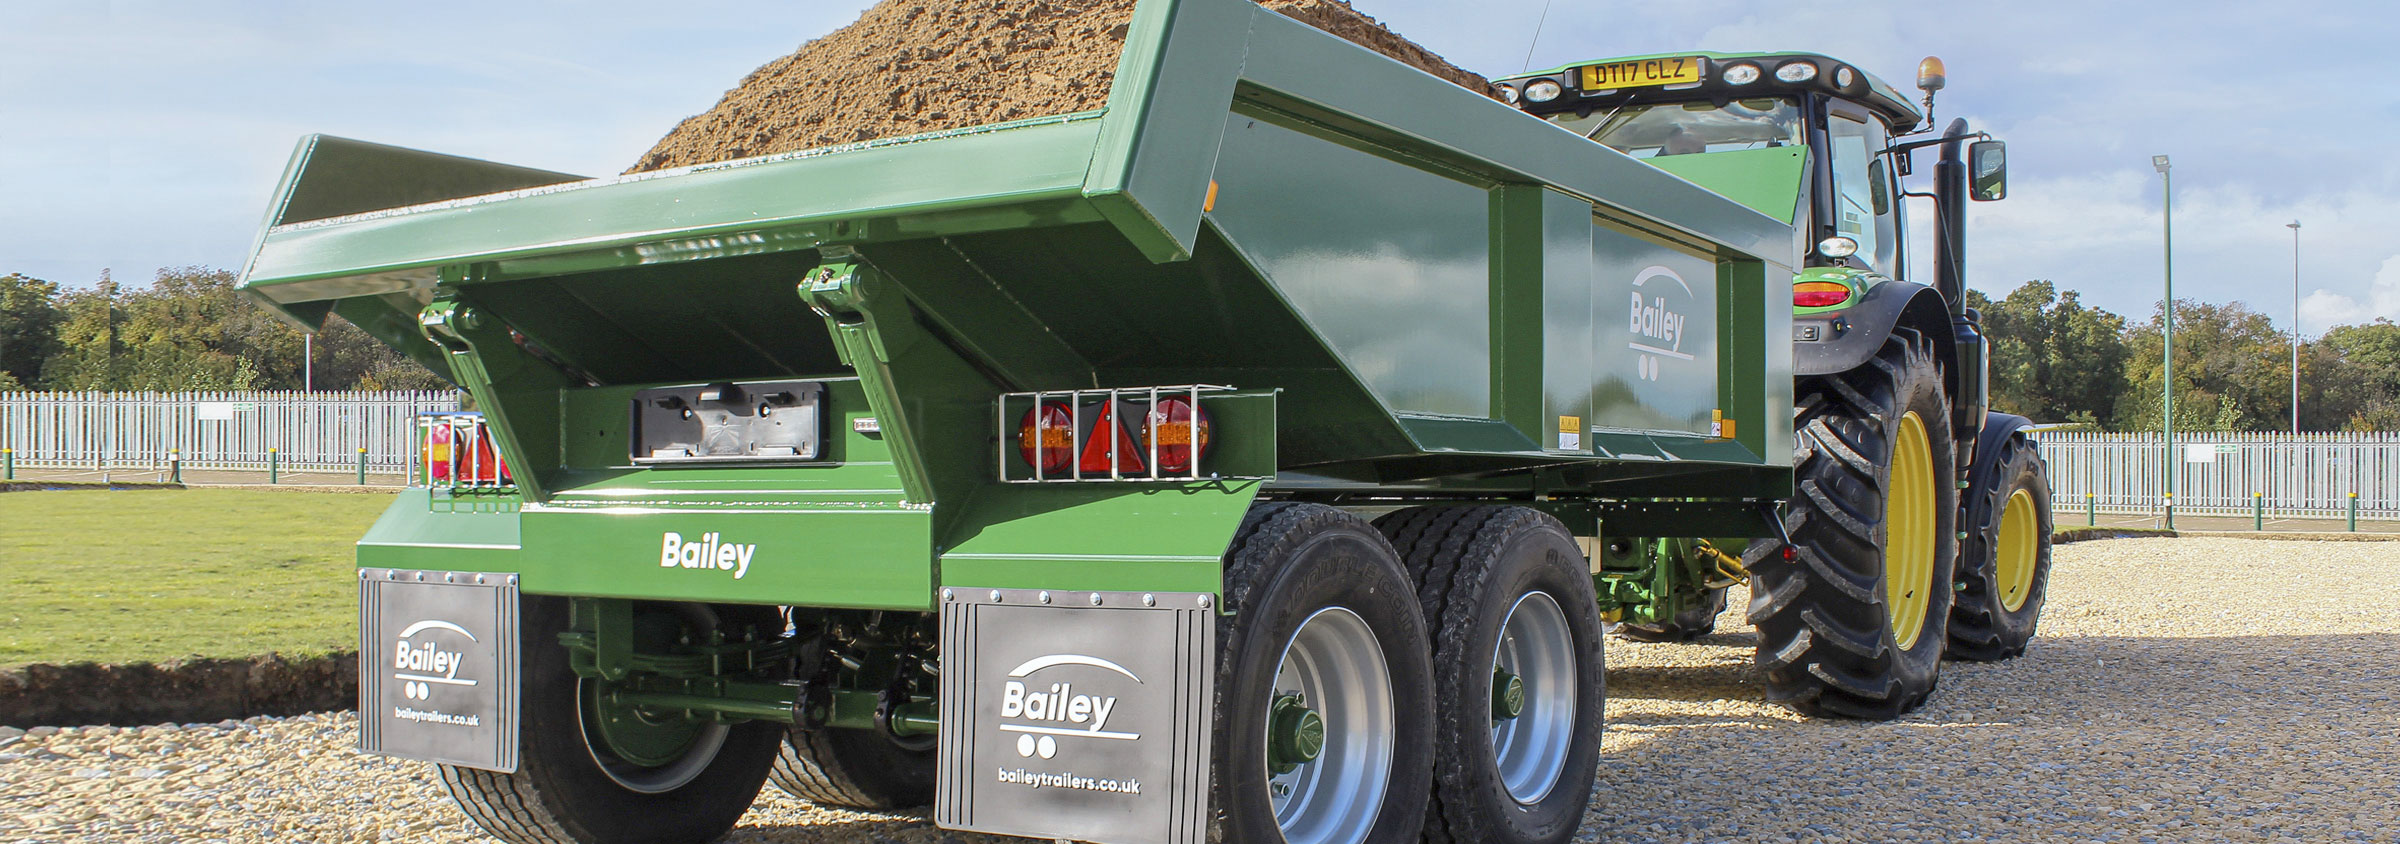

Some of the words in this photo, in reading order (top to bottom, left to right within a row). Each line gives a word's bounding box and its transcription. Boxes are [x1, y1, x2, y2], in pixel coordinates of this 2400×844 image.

[1595, 63, 1639, 85] DT17
[1645, 59, 1685, 80] CLZ
[1629, 291, 1684, 352] Bailey
[660, 532, 756, 580] Bailey
[395, 640, 463, 679] Bailey
[395, 707, 479, 727] baileytrailers.co.uk
[1001, 681, 1117, 732] Bailey
[998, 767, 1141, 795] baileytrailers.co.uk
